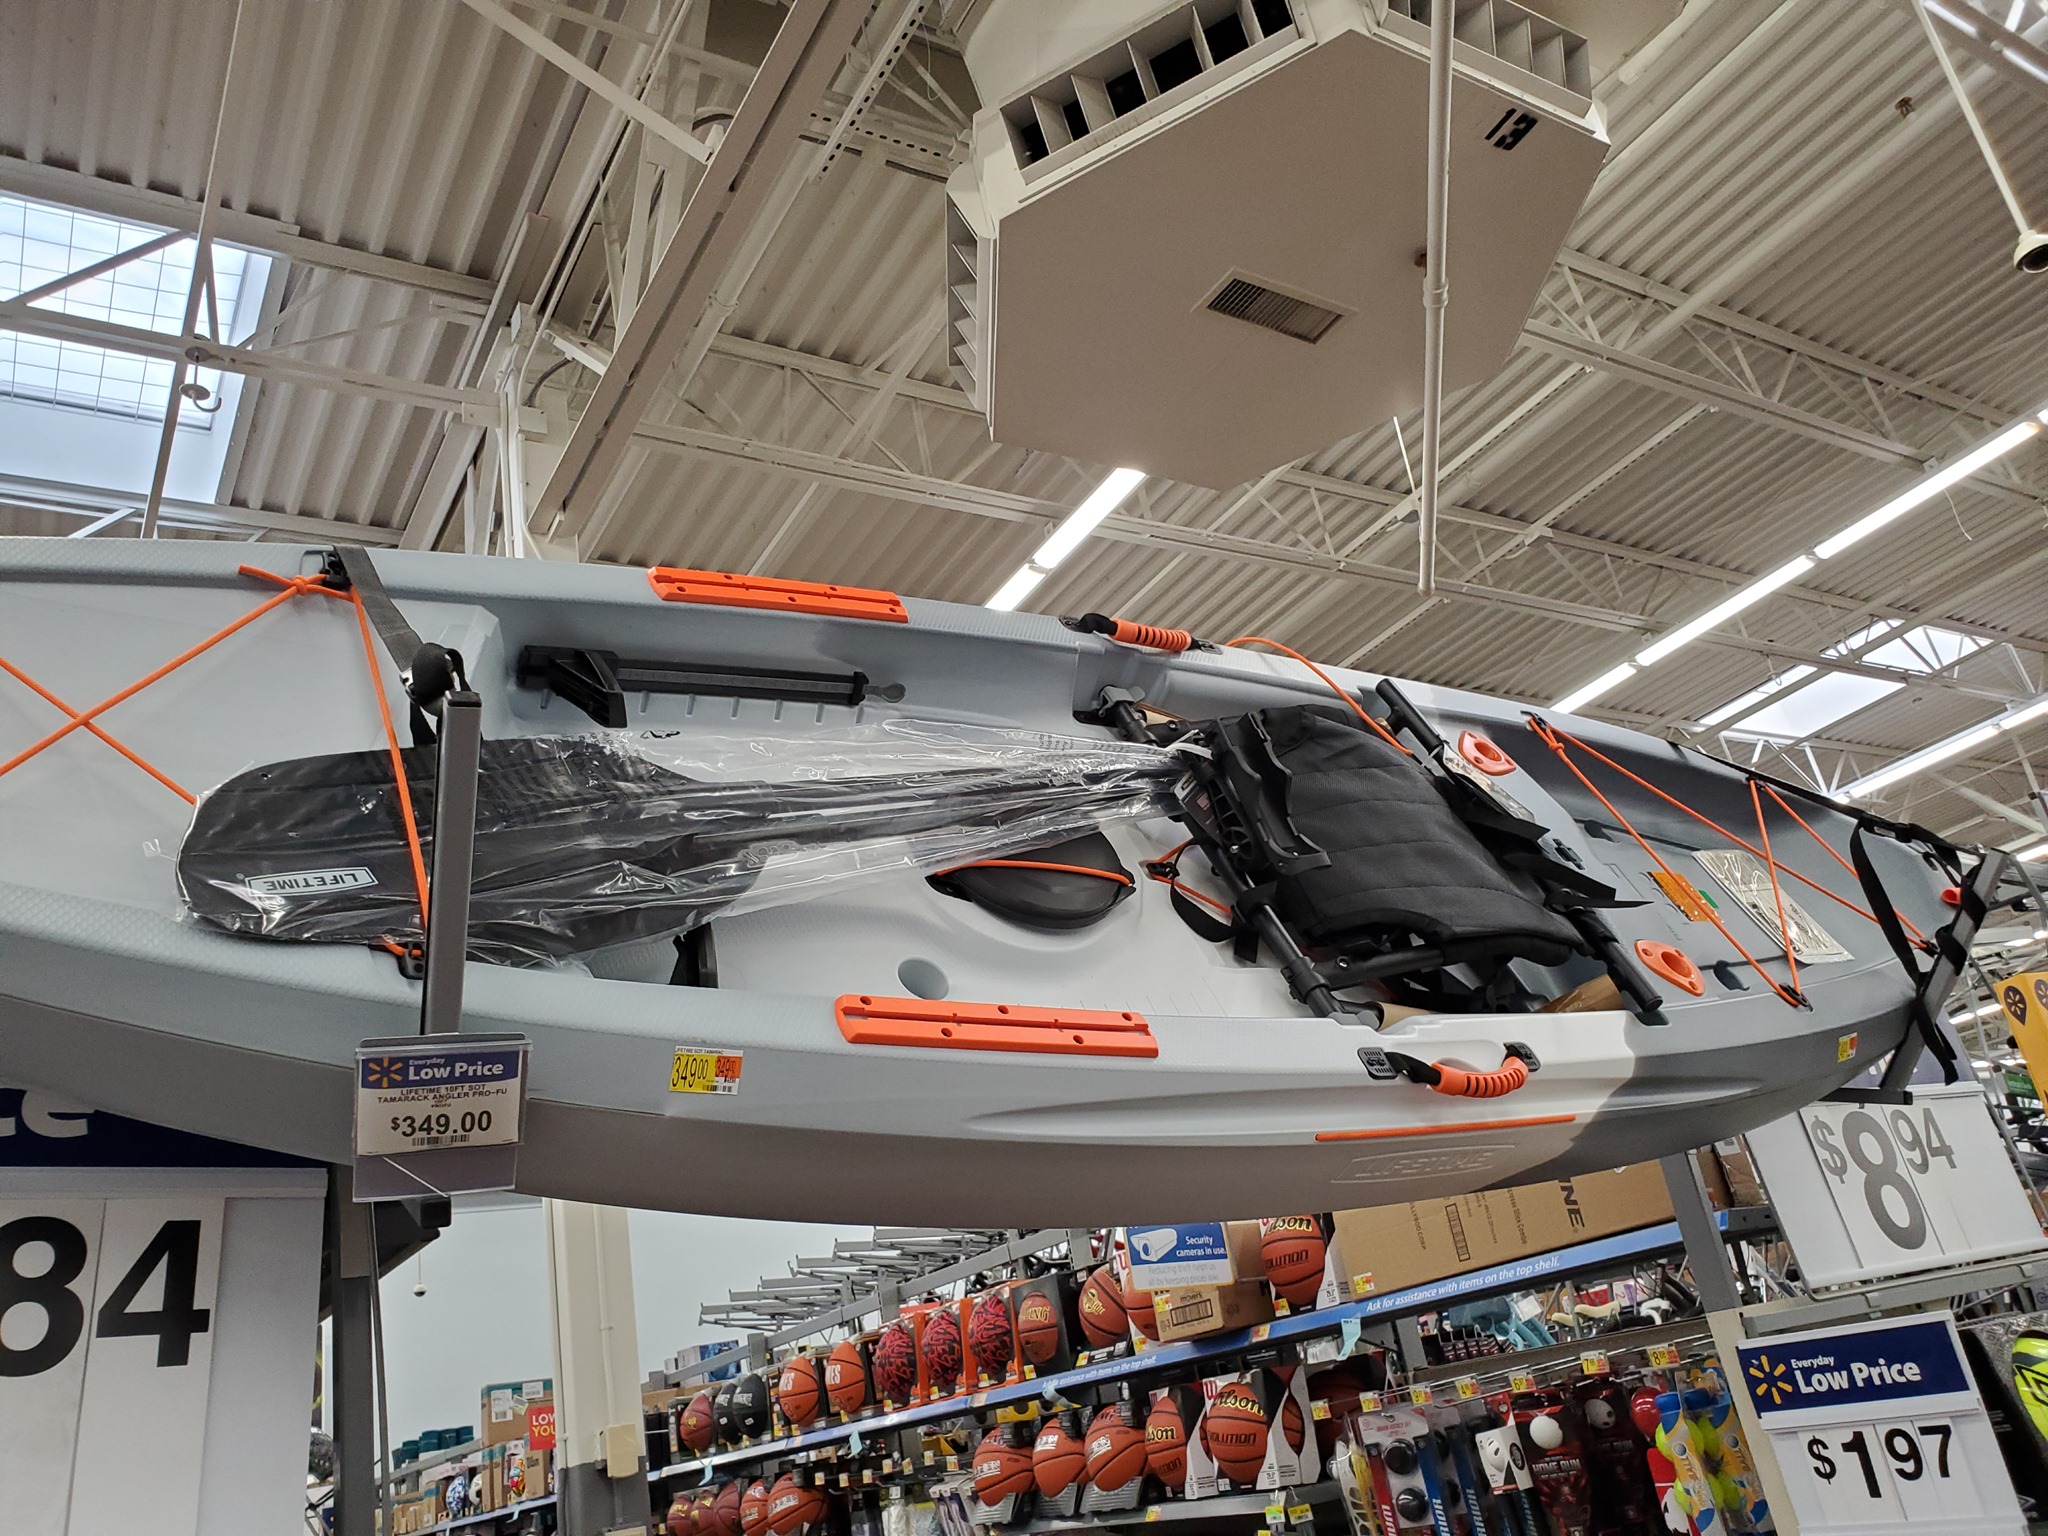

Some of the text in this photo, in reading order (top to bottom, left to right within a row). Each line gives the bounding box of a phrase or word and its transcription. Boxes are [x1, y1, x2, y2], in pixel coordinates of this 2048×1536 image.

[1484, 107, 1538, 151] 13
[263, 872, 360, 892] LIFETIME
[409, 1057, 445, 1066] Everyday
[408, 1061, 504, 1081] Low Price
[377, 1088, 507, 1104] TAMARACK ANGLER PRO-FU
[401, 1083, 487, 1096] LIFETIME 10FT SOT
[391, 1110, 492, 1138] $349.00
[1185, 1235, 1213, 1246] Security
[1176, 1248, 1205, 1257] cameras
[1205, 1247, 1213, 1255] in
[1366, 1256, 1560, 1312] Ask for assistance with items on the top shelf.
[1790, 1355, 1835, 1369] Everyday
[1794, 1357, 1922, 1394] Low Price
[1532, 1459, 1581, 1474] HOME RUN
